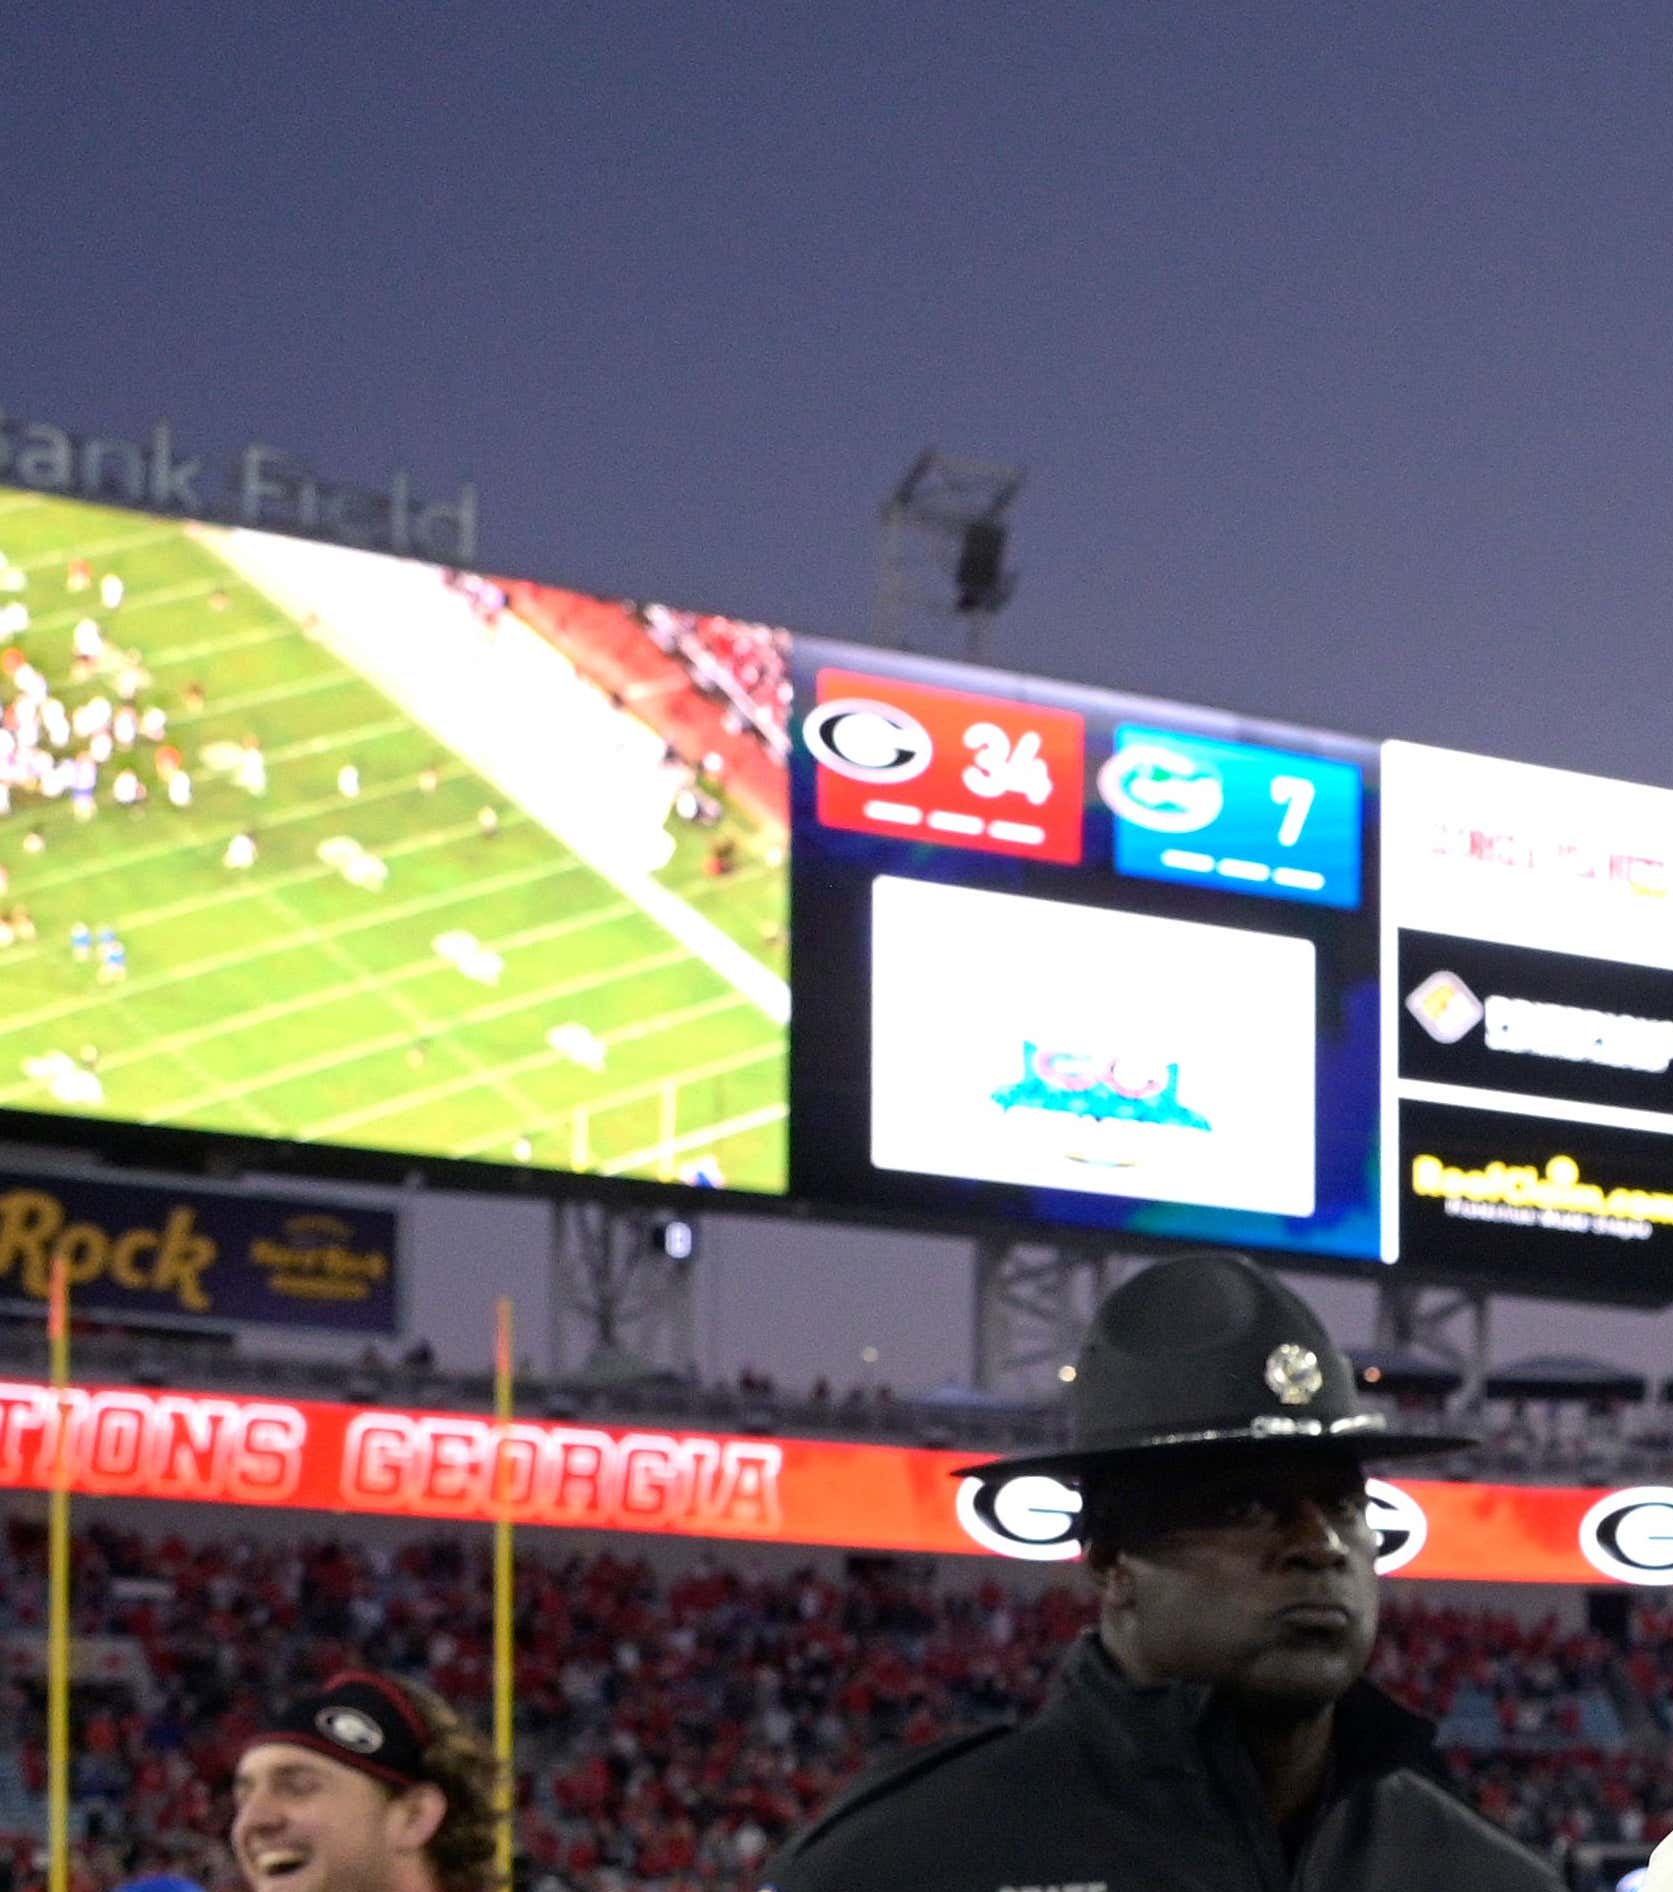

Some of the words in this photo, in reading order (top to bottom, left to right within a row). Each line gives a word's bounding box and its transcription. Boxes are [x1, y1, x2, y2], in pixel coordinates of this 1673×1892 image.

[0, 415, 200, 508] ank
[962, 722, 1053, 805] 34
[1269, 775, 1316, 847] 7
[0, 1189, 218, 1312] Rock
[340, 1410, 783, 1537] GEORGIA
